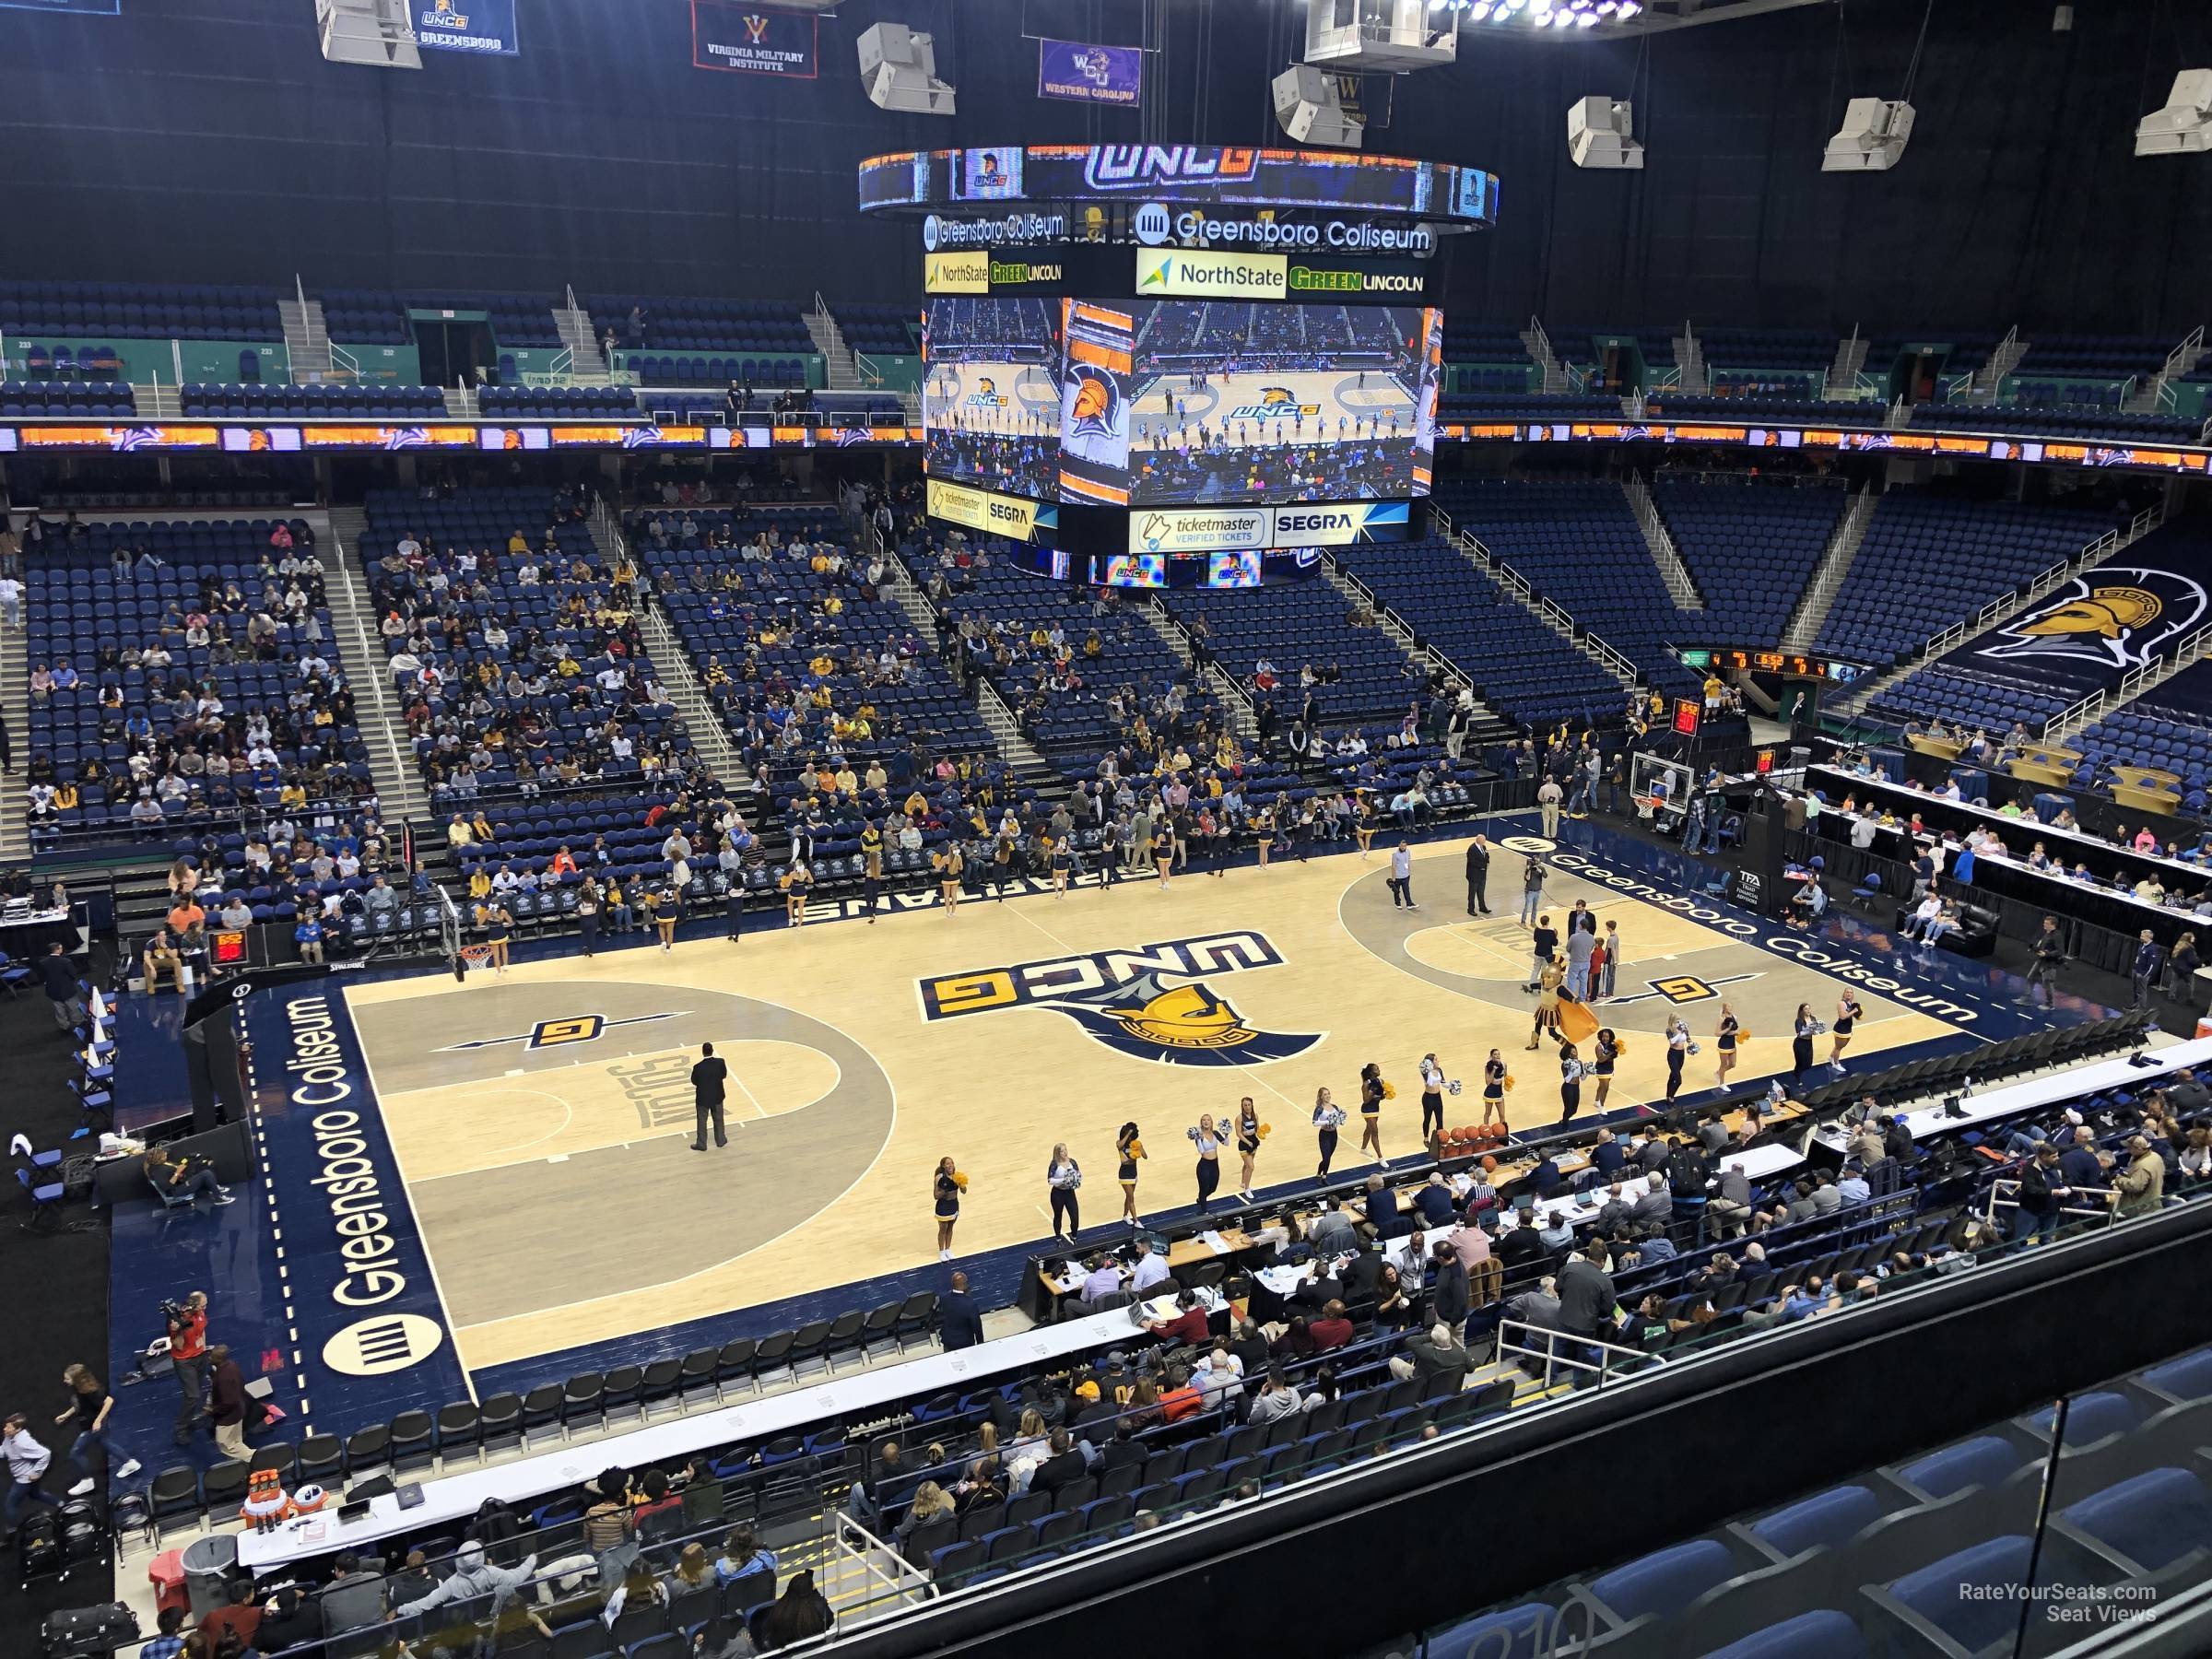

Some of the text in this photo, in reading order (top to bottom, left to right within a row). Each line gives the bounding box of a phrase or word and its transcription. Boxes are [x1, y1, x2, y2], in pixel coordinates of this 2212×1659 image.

[423, 12, 467, 28] UNCG
[420, 31, 501, 50] GREENSBORO
[708, 43, 804, 63] VIRGINIA MILITARY
[729, 57, 783, 72] INSTITUTE
[1045, 83, 1135, 100] WESTERN CAROLINA
[1097, 145, 1253, 180] UNCG
[940, 214, 1064, 243] Greensboro Coliseum
[1176, 213, 1430, 250] Greensboro Coliseum
[943, 262, 1062, 284] NorthState GREEN LINCOLN
[1182, 265, 1283, 287] NorthState
[1290, 266, 1424, 292] GREEN LINCOLN
[967, 394, 1008, 406] UNCG
[1231, 405, 1321, 418] UNCG
[946, 491, 980, 510] ticketmaster
[990, 502, 1028, 525] SEGRA
[1177, 517, 1255, 533] ticketmaster
[1277, 513, 1352, 532] SEGRA
[1176, 533, 1252, 544] VERIFIED TICKETS
[1116, 568, 1148, 579] UNCG
[1218, 569, 1249, 579] UNCG
[1760, 653, 1783, 665] 6:52
[1681, 703, 1697, 715] 6:52
[1739, 870, 1761, 888] TFA
[1742, 883, 1756, 892] TRIAD
[1736, 887, 1759, 900] FINANCIAL
[1736, 894, 1758, 905] ADVISORS
[218, 934, 242, 945] 6:52
[1550, 853, 1759, 936] Greensboro
[1767, 936, 1979, 1023] Coliseum
[330, 961, 365, 971] SPALDING
[934, 935, 1269, 1014] UNCG
[287, 996, 406, 1307] Greensboro Coliseum
